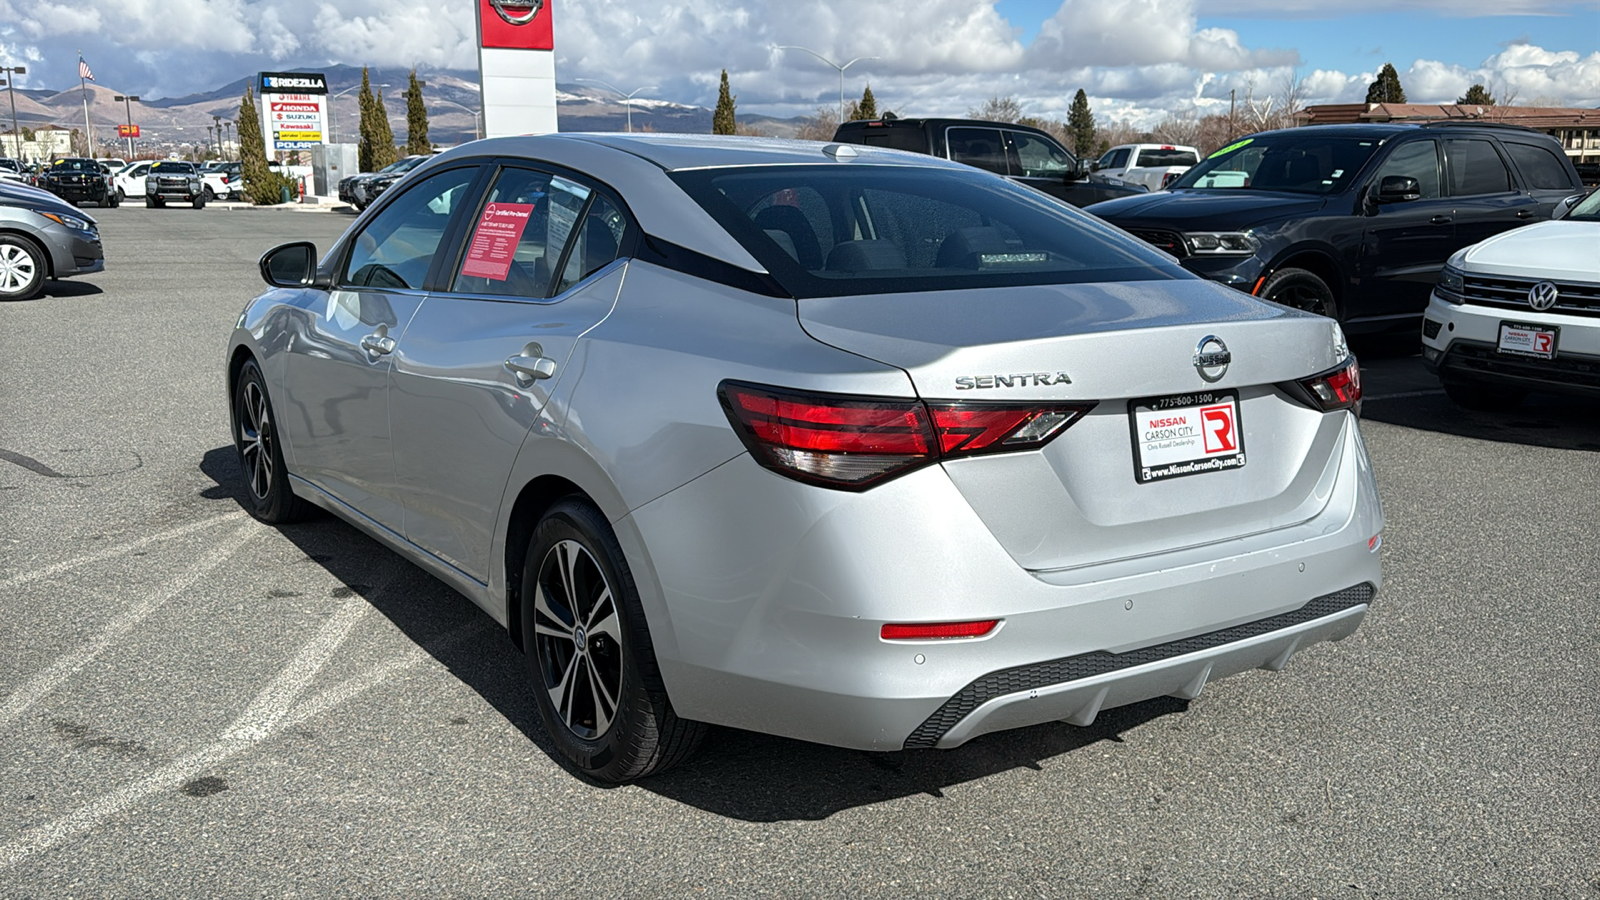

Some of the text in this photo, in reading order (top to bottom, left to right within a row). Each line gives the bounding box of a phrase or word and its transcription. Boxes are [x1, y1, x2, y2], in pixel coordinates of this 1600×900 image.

[278, 78, 324, 88] RIDEZILLA
[1200, 353, 1230, 364] NISSAN
[955, 372, 1072, 390] SENTRA
[1160, 394, 1212, 408] 775-600-1500
[1150, 416, 1186, 429] NISSAN
[1145, 426, 1194, 441] CARSON CITY
[1172, 438, 1196, 448] Dealership
[1152, 458, 1238, 478] www.NissanCarsonCity.com
